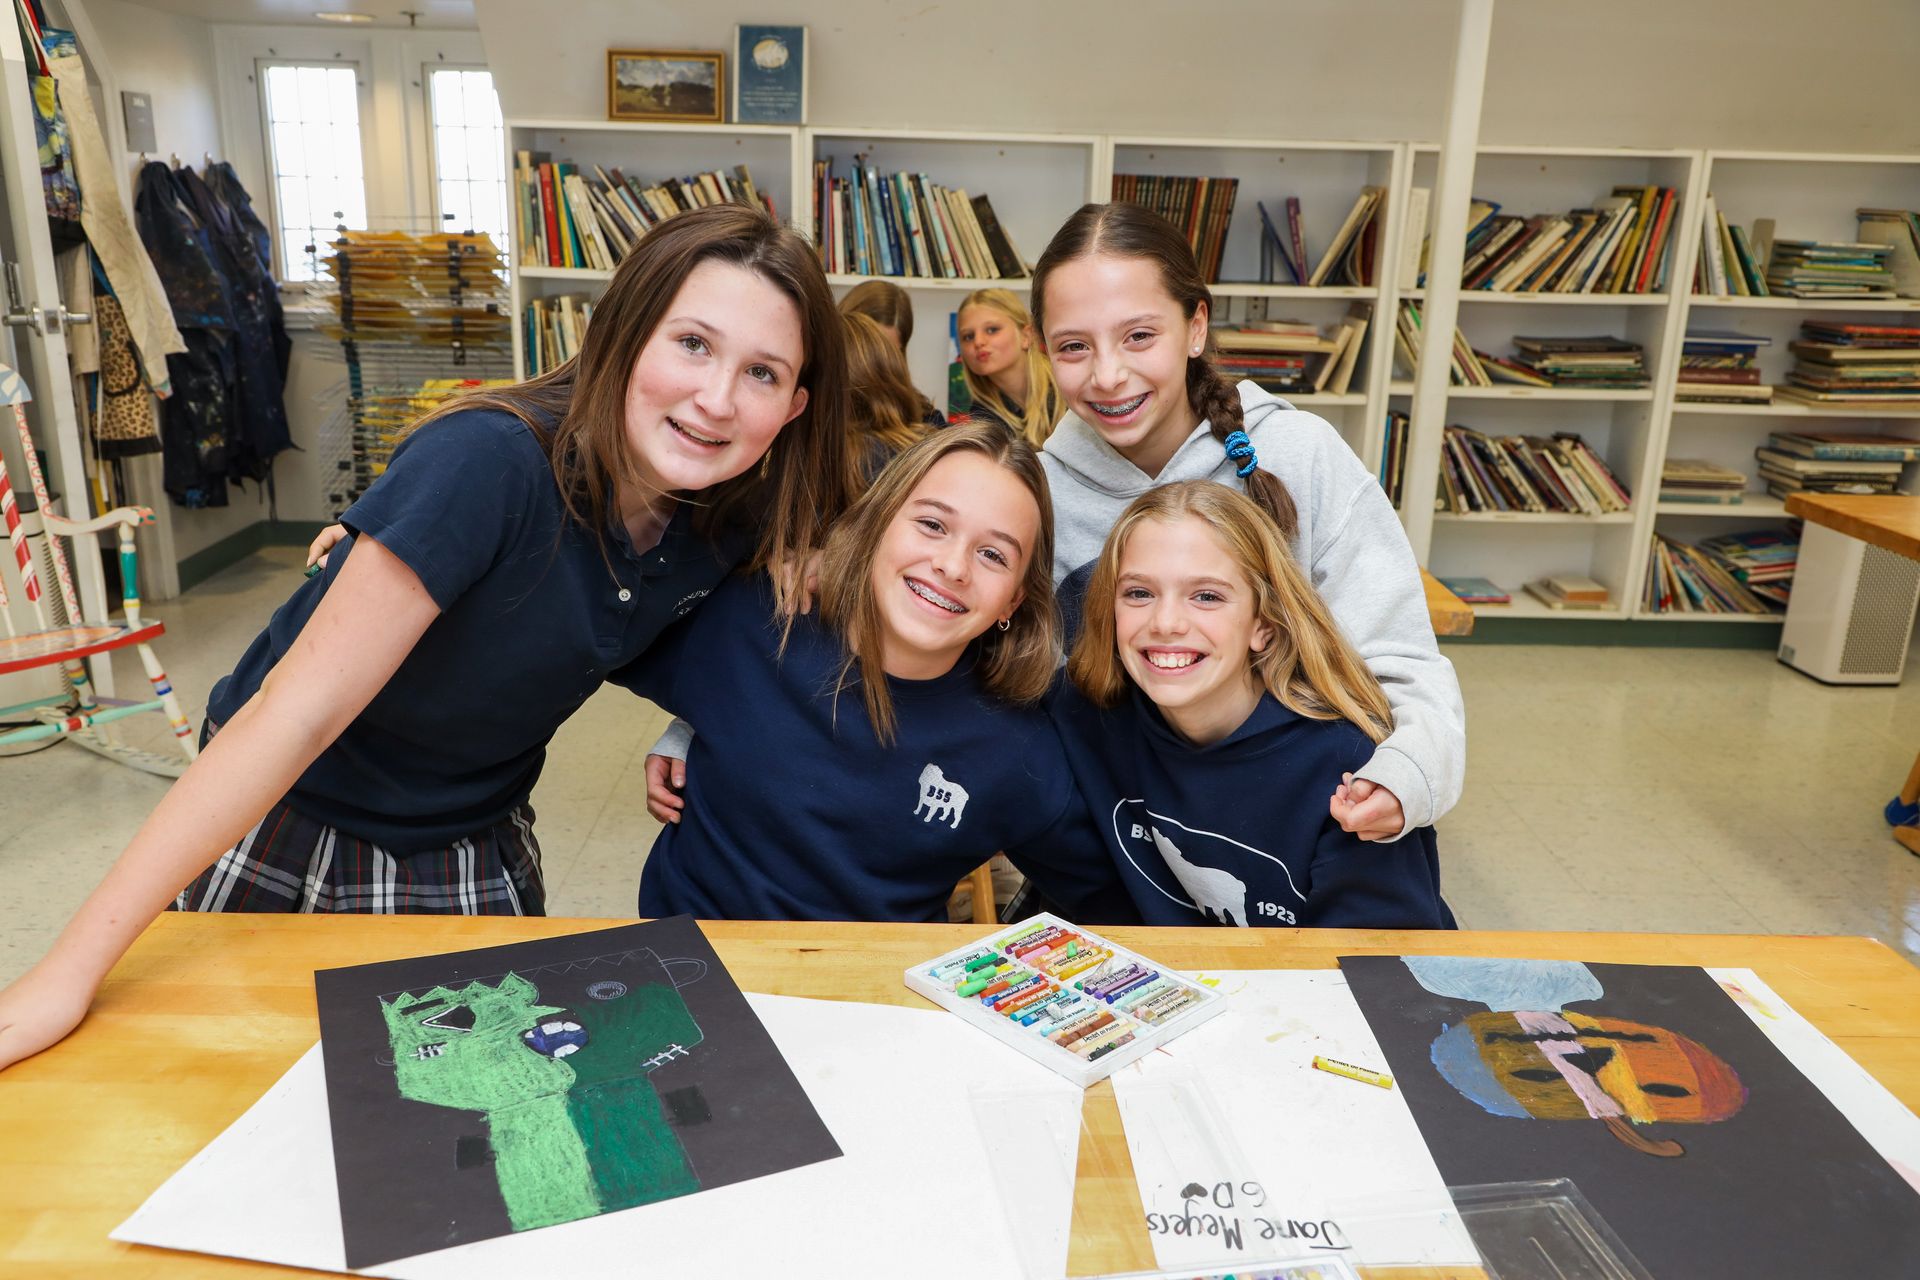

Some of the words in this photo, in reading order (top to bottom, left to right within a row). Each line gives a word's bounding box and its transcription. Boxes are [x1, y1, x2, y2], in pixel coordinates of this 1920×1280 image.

[926, 785, 953, 804] BSS
[1256, 901, 1297, 925] 1923
[1146, 1199, 1244, 1251] Meyers
[1259, 1217, 1352, 1251] Jane
